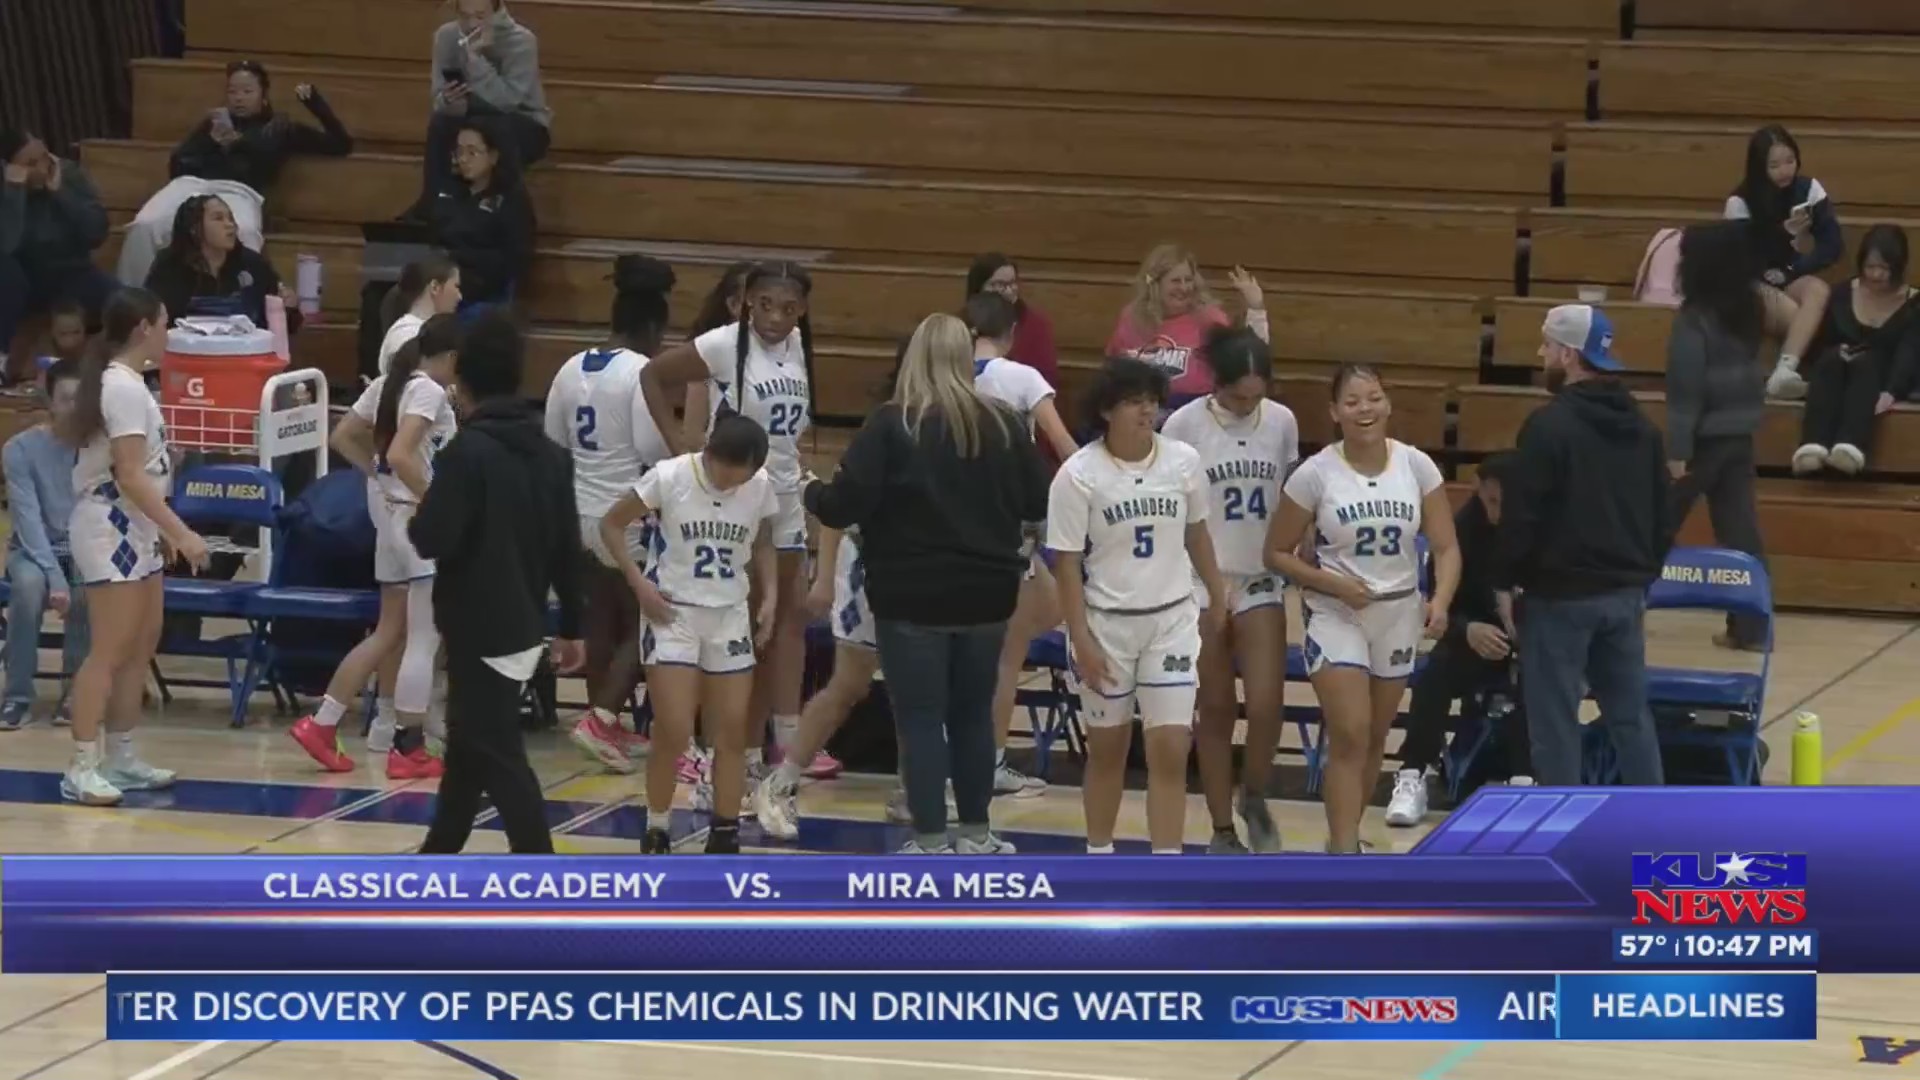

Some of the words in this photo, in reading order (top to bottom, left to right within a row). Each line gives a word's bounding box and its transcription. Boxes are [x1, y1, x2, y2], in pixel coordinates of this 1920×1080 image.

[186, 377, 205, 397] G
[575, 405, 598, 451] 2
[769, 403, 803, 436] 22
[186, 481, 223, 498] MIRA
[226, 482, 266, 500] MESA
[1223, 485, 1267, 521] 24
[1102, 497, 1178, 526] MARAUDERS
[1336, 499, 1415, 526] MARAUDERS
[1132, 524, 1154, 559] 5
[1355, 526, 1402, 557] 23
[693, 544, 735, 579] 25
[1661, 565, 1703, 583] MIRA
[1707, 568, 1751, 585] MESA
